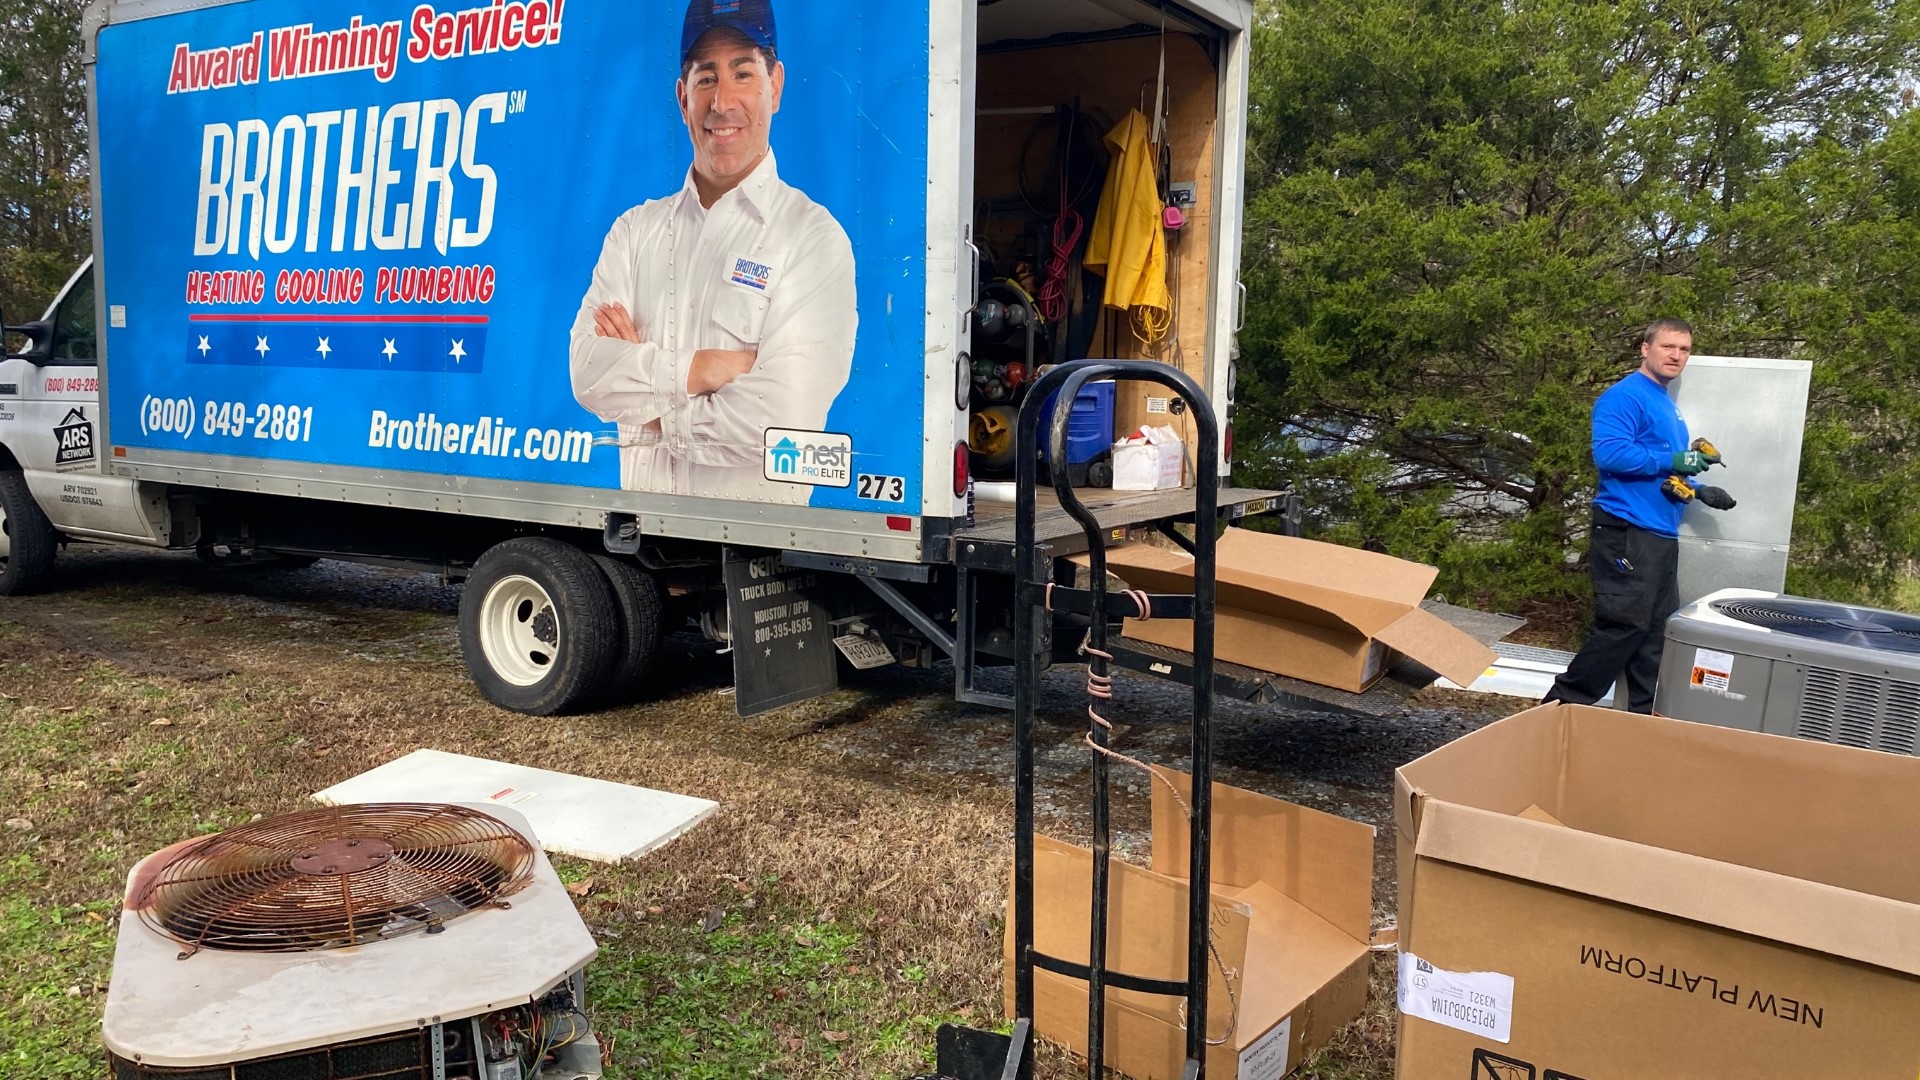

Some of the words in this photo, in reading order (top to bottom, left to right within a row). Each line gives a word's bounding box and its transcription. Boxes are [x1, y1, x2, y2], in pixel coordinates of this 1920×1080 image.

[168, 33, 262, 93] Award
[269, 16, 402, 83] Winning
[407, 0, 564, 63] Service!
[194, 92, 508, 261] BROTHERS
[509, 90, 527, 114] SM
[735, 258, 772, 280] BROTHERS
[186, 268, 265, 303] HEATING
[275, 266, 364, 303] COOLING
[375, 264, 495, 303] PLUMBING
[45, 377, 64, 394] (800)
[139, 394, 196, 440] (800)
[203, 400, 313, 442] 849-2881
[62, 426, 90, 449] ARS
[368, 410, 593, 464] BrotherAir.com
[62, 447, 91, 460] NETWORK
[803, 442, 847, 467] nest
[802, 466, 819, 477] PRO
[821, 468, 845, 480] ELITE
[859, 475, 903, 501] 273
[749, 554, 801, 579] GENE
[740, 583, 765, 602] TRUCK
[767, 580, 785, 595] BODY
[754, 604, 788, 624] HOUSTON
[794, 600, 810, 616] DFW
[755, 617, 813, 644] 800-395-8585
[1415, 977, 1427, 988] ST
[1580, 945, 1739, 1006] PLATFORM
[1470, 991, 1496, 1009] W3321
[1748, 990, 1824, 1029] NEW
